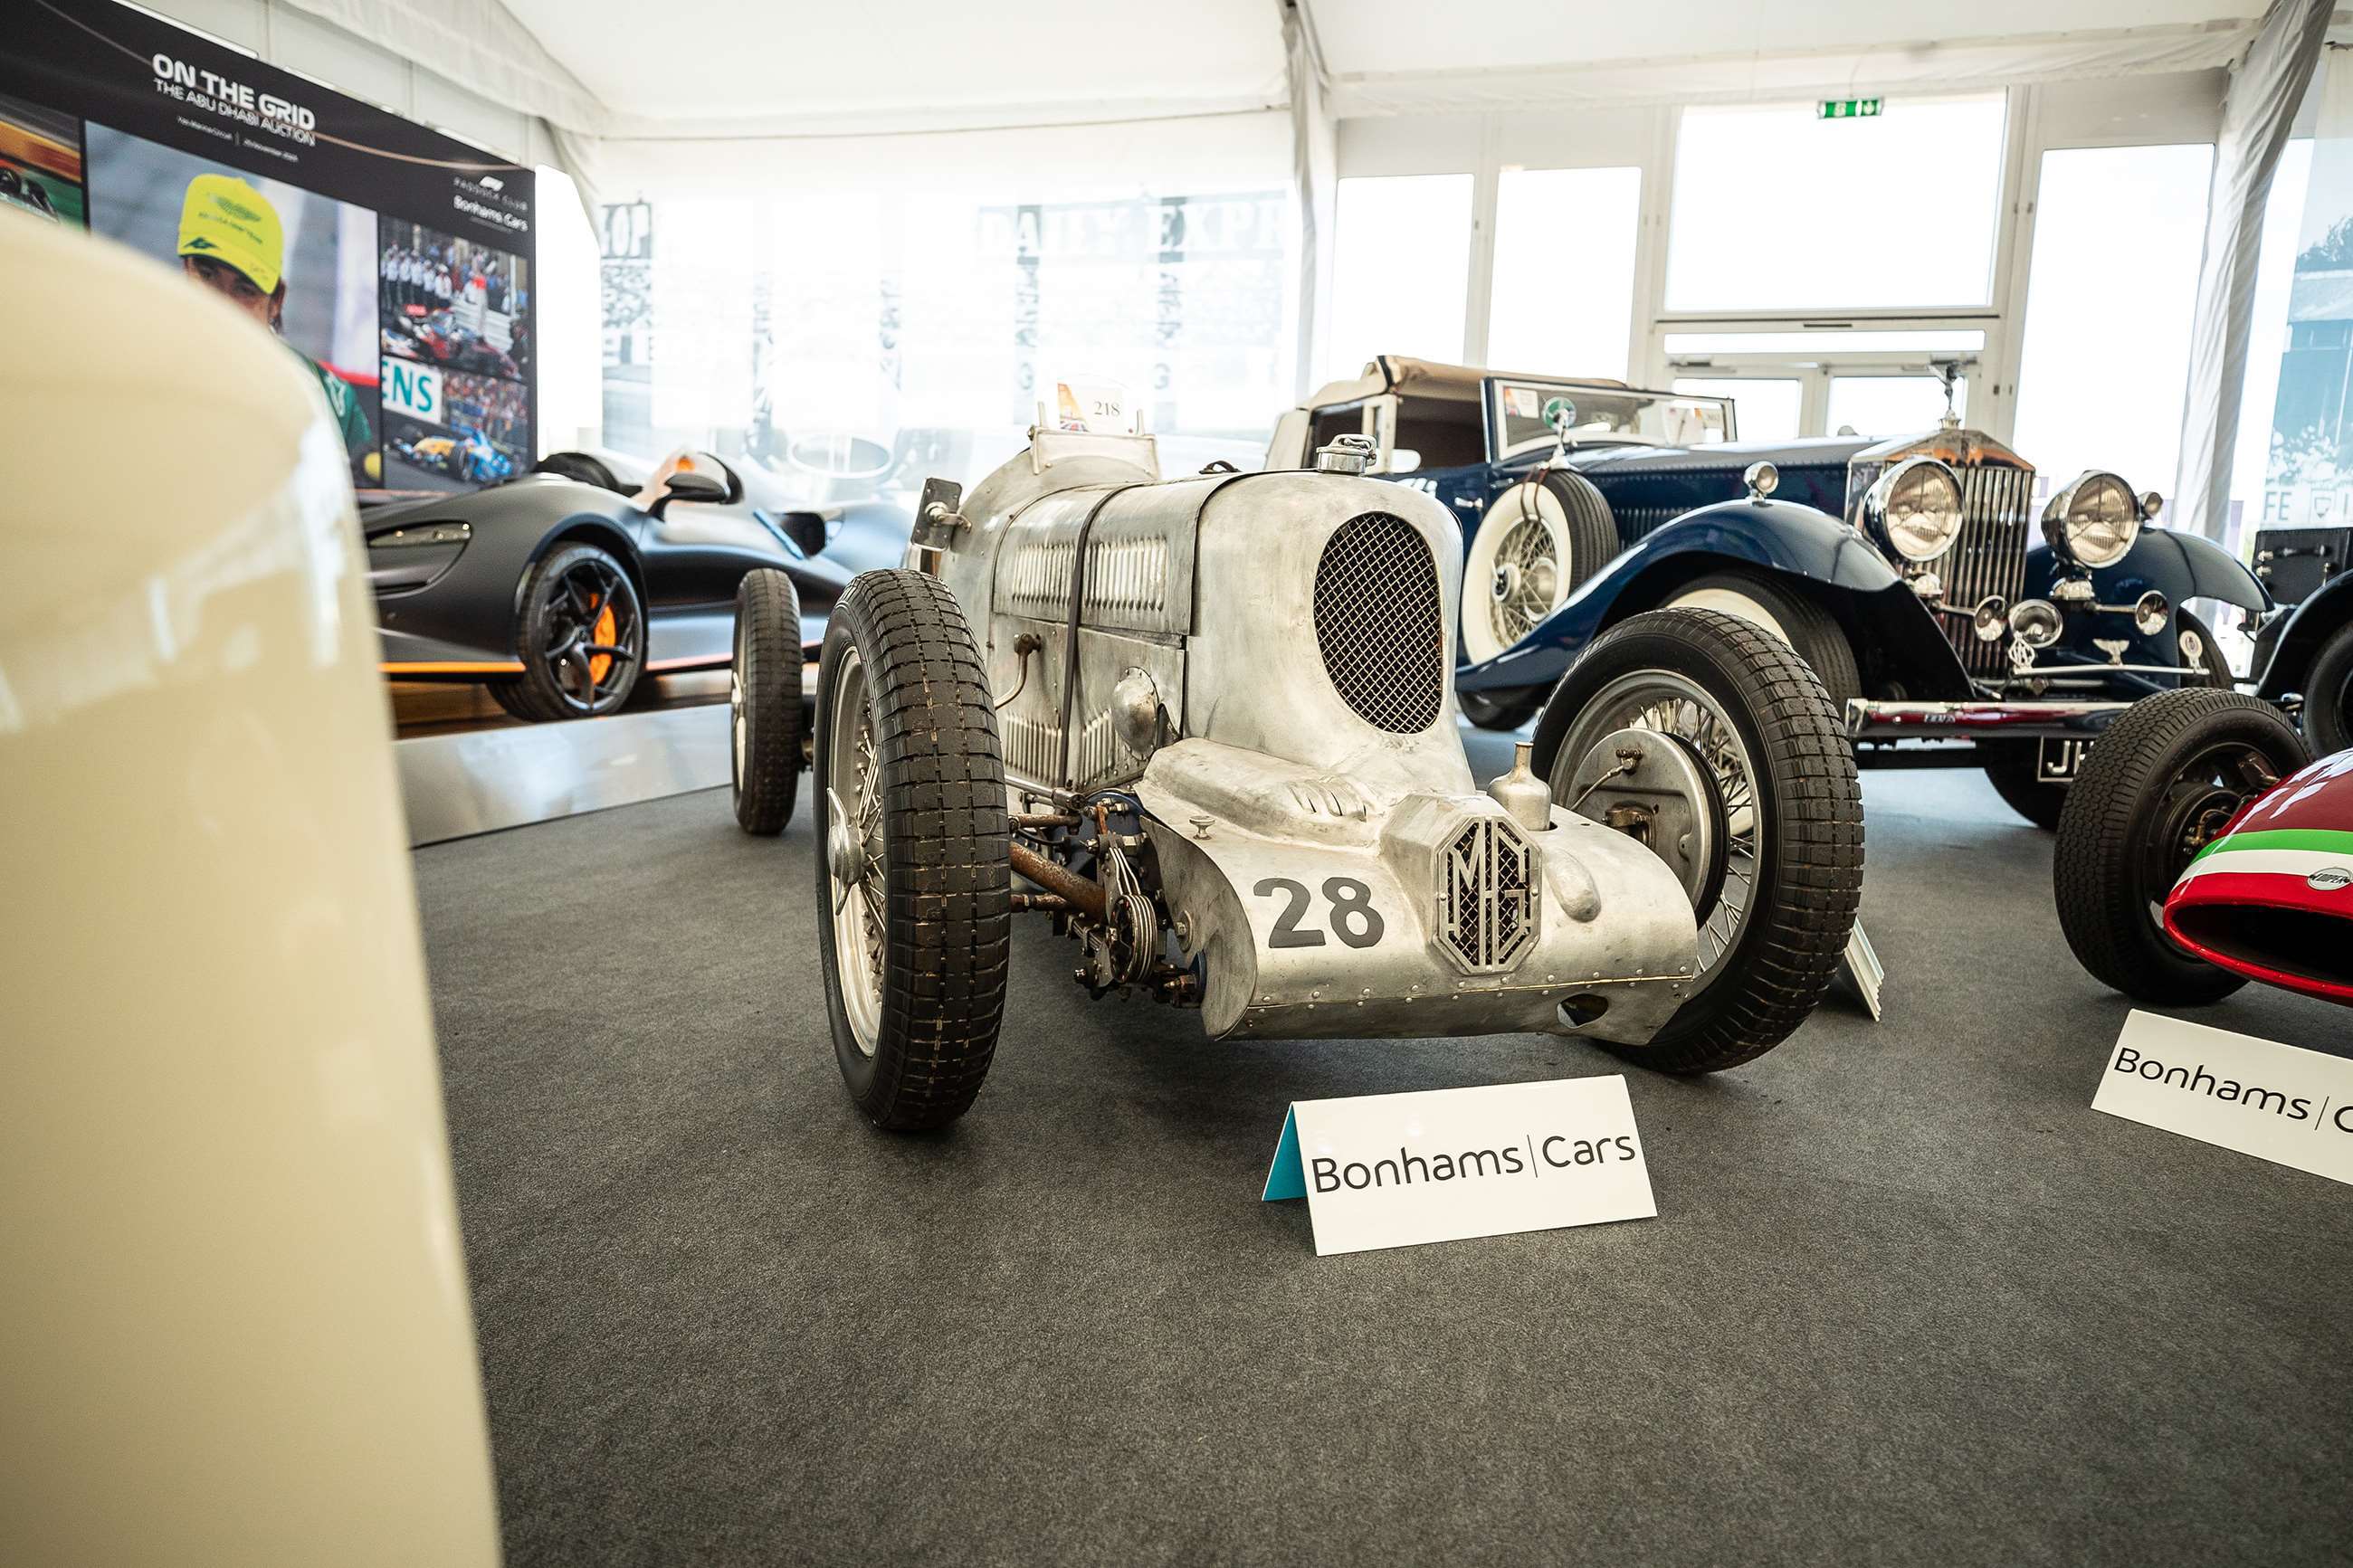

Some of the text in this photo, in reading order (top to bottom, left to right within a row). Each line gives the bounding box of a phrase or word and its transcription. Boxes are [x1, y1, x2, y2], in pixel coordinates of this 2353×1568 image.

[152, 52, 196, 89] ON
[199, 69, 256, 111] THE
[258, 92, 316, 130] GRID
[153, 78, 185, 101] THE
[186, 90, 216, 112] ABU
[217, 101, 261, 128] DHABI
[261, 118, 316, 147] AUCTION
[1092, 400, 1121, 417] 218
[1253, 877, 1385, 949] 28
[2113, 1046, 2312, 1120] Bonhams
[1311, 1135, 1636, 1194] Bonhams Cars
